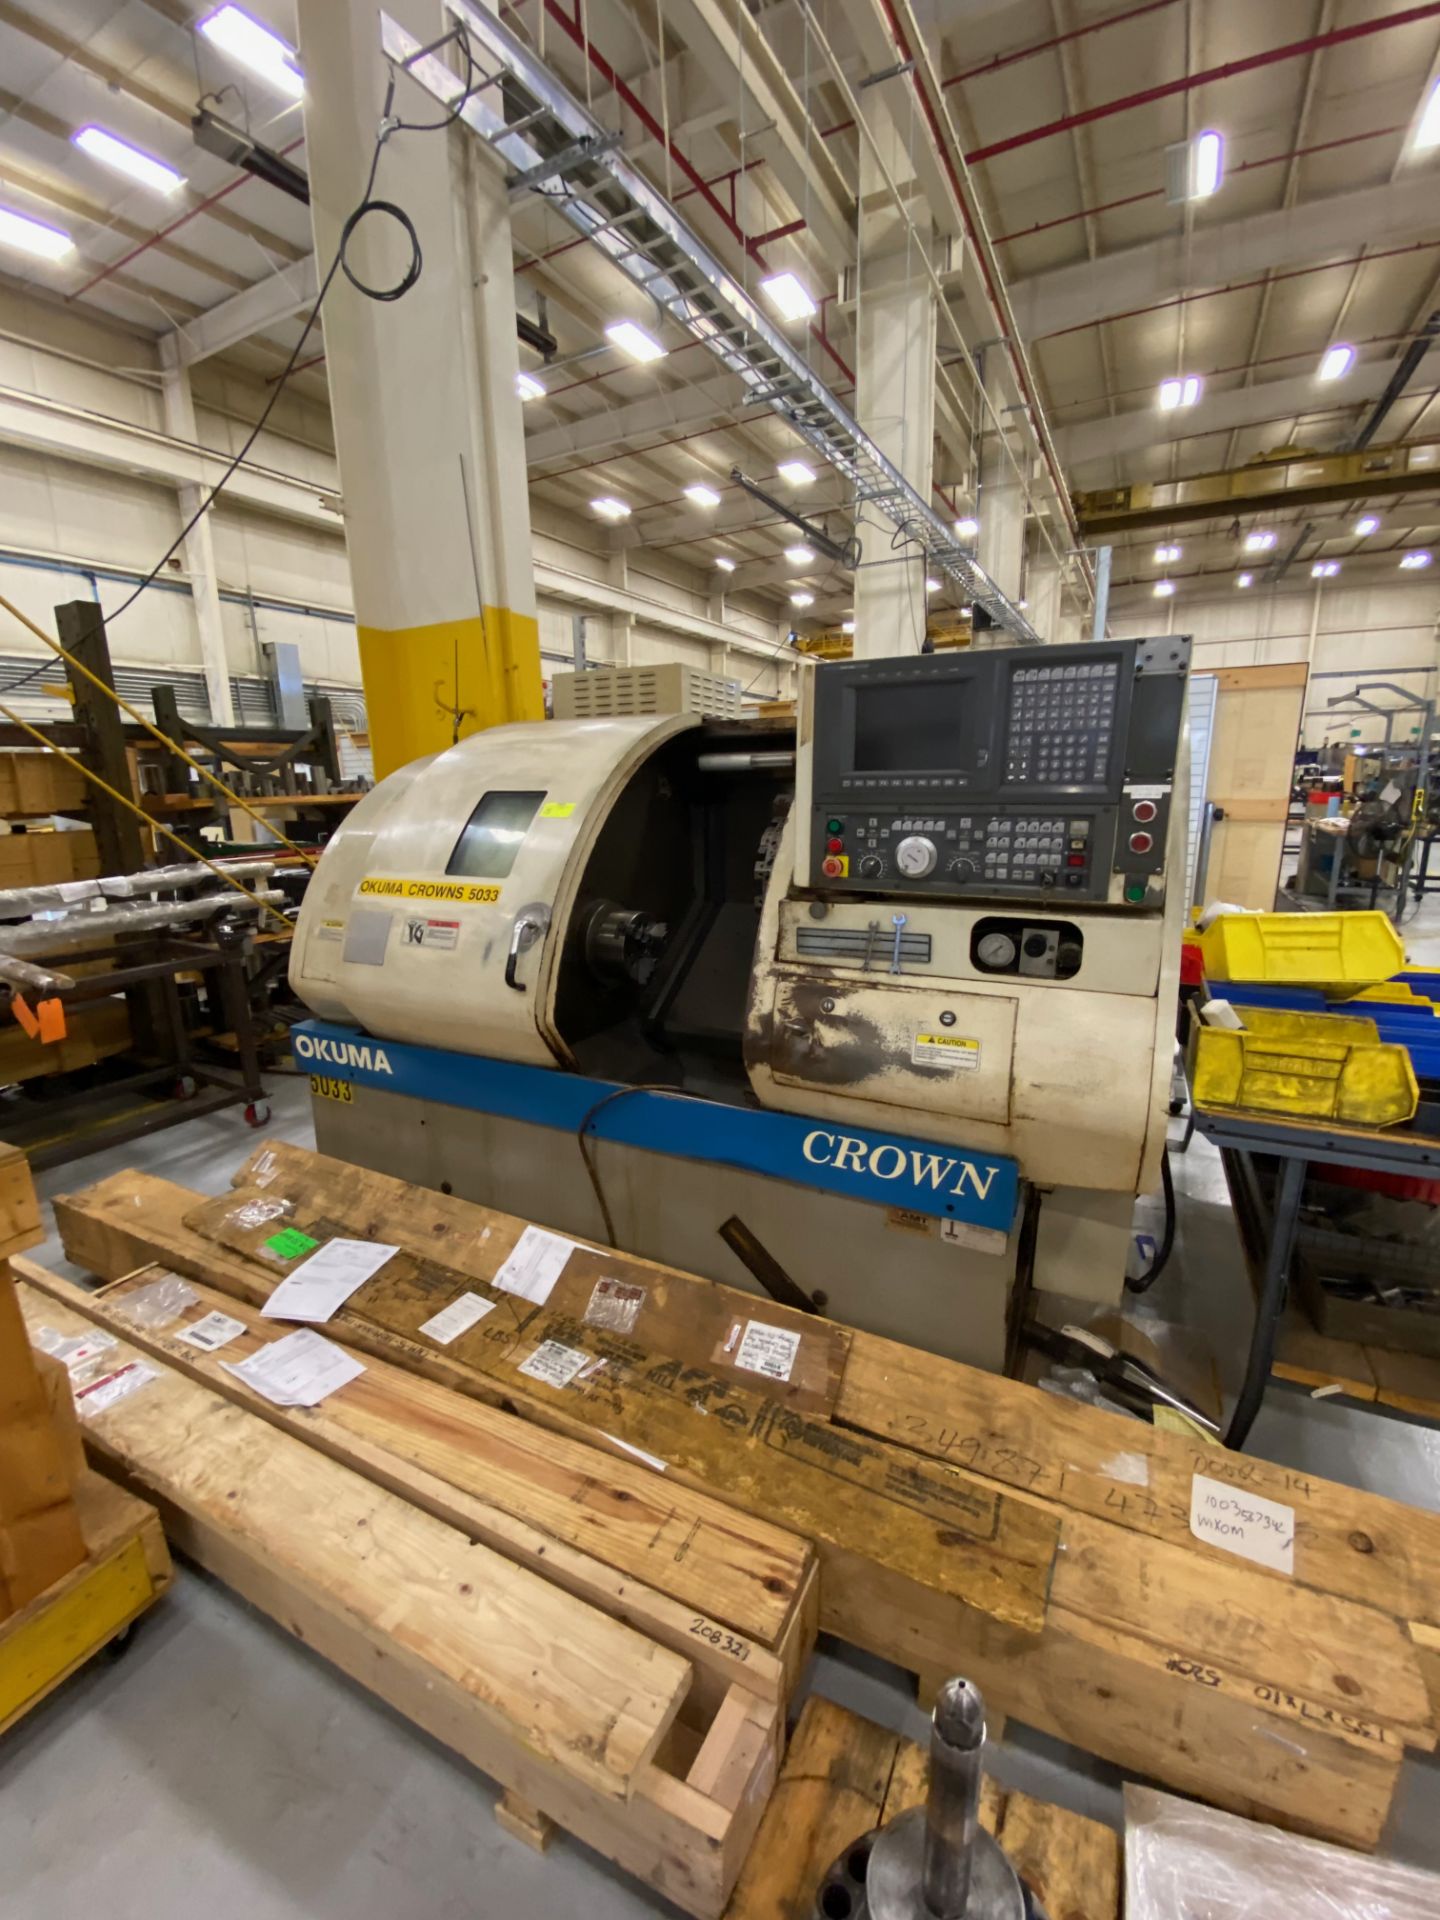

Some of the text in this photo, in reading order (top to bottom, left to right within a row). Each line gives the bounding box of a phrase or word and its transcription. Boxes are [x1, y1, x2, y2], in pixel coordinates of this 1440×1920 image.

[359, 880, 500, 902] OKUMA CROWNS 5033
[295, 1034, 393, 1075] OKUMA
[937, 1036, 967, 1048] CAUTION
[310, 1073, 351, 1102] 5033
[802, 1130, 1000, 1200] CROWN
[689, 1618, 750, 1661] 208321
